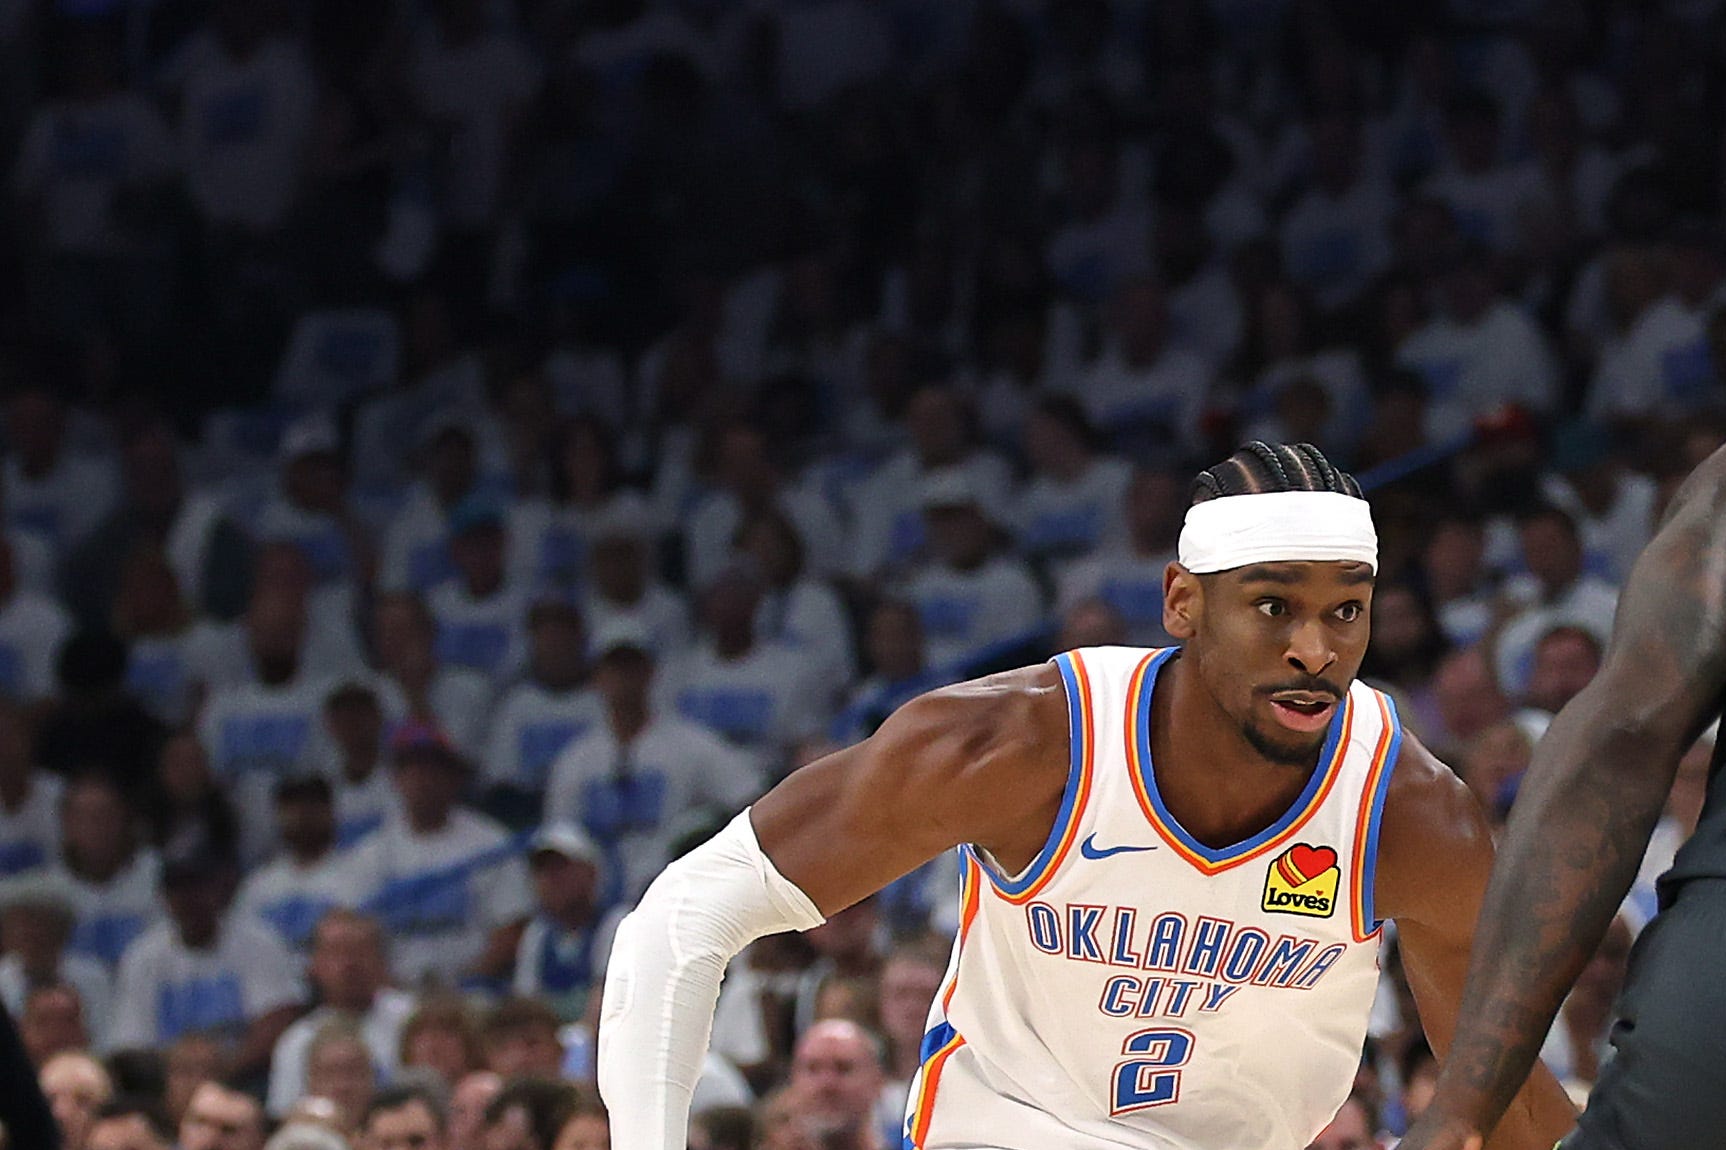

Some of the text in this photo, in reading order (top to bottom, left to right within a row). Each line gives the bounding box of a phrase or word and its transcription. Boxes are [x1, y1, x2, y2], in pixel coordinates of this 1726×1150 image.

[1026, 901, 1347, 991] OKLAHOMA
[1099, 975, 1243, 1018] CITY
[1109, 1027, 1196, 1117] 2
